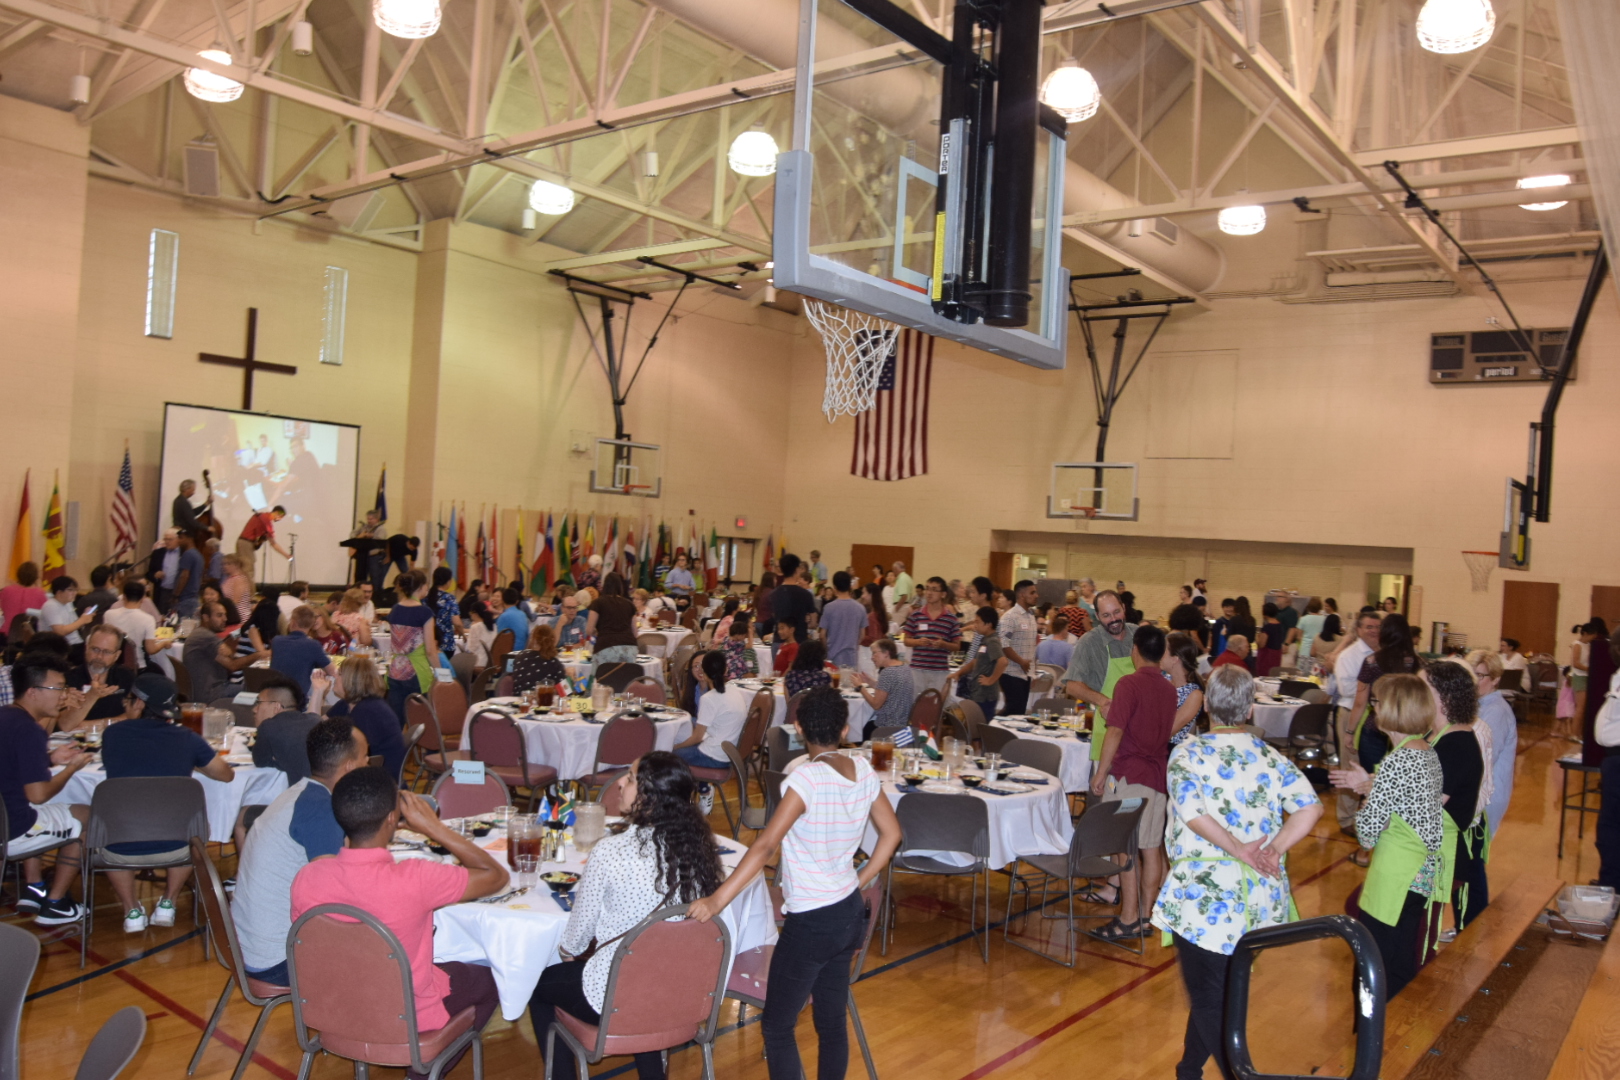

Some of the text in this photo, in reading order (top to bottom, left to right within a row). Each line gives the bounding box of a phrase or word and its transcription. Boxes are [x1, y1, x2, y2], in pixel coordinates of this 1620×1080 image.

[941, 135, 950, 172] PORTER
[1484, 366, 1515, 378] period
[575, 701, 588, 710] 30
